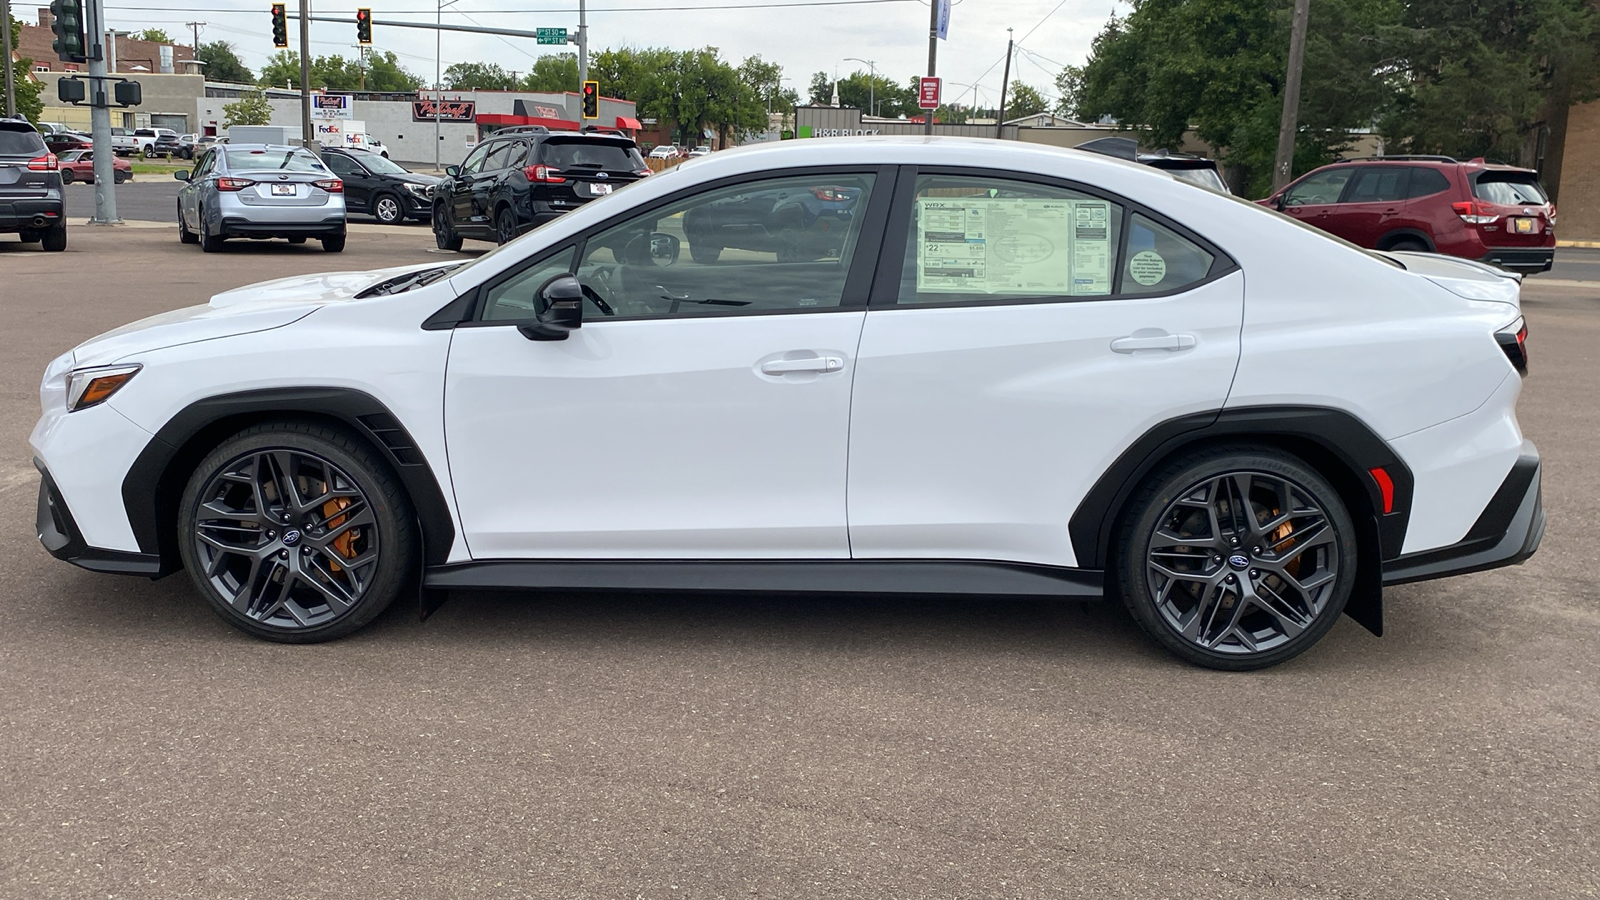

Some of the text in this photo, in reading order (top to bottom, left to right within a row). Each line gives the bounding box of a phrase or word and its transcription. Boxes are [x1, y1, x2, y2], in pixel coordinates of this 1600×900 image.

[319, 125, 340, 133] FedEx
[814, 128, 880, 137] H&R BLOCK
[346, 134, 361, 144] FedEx
